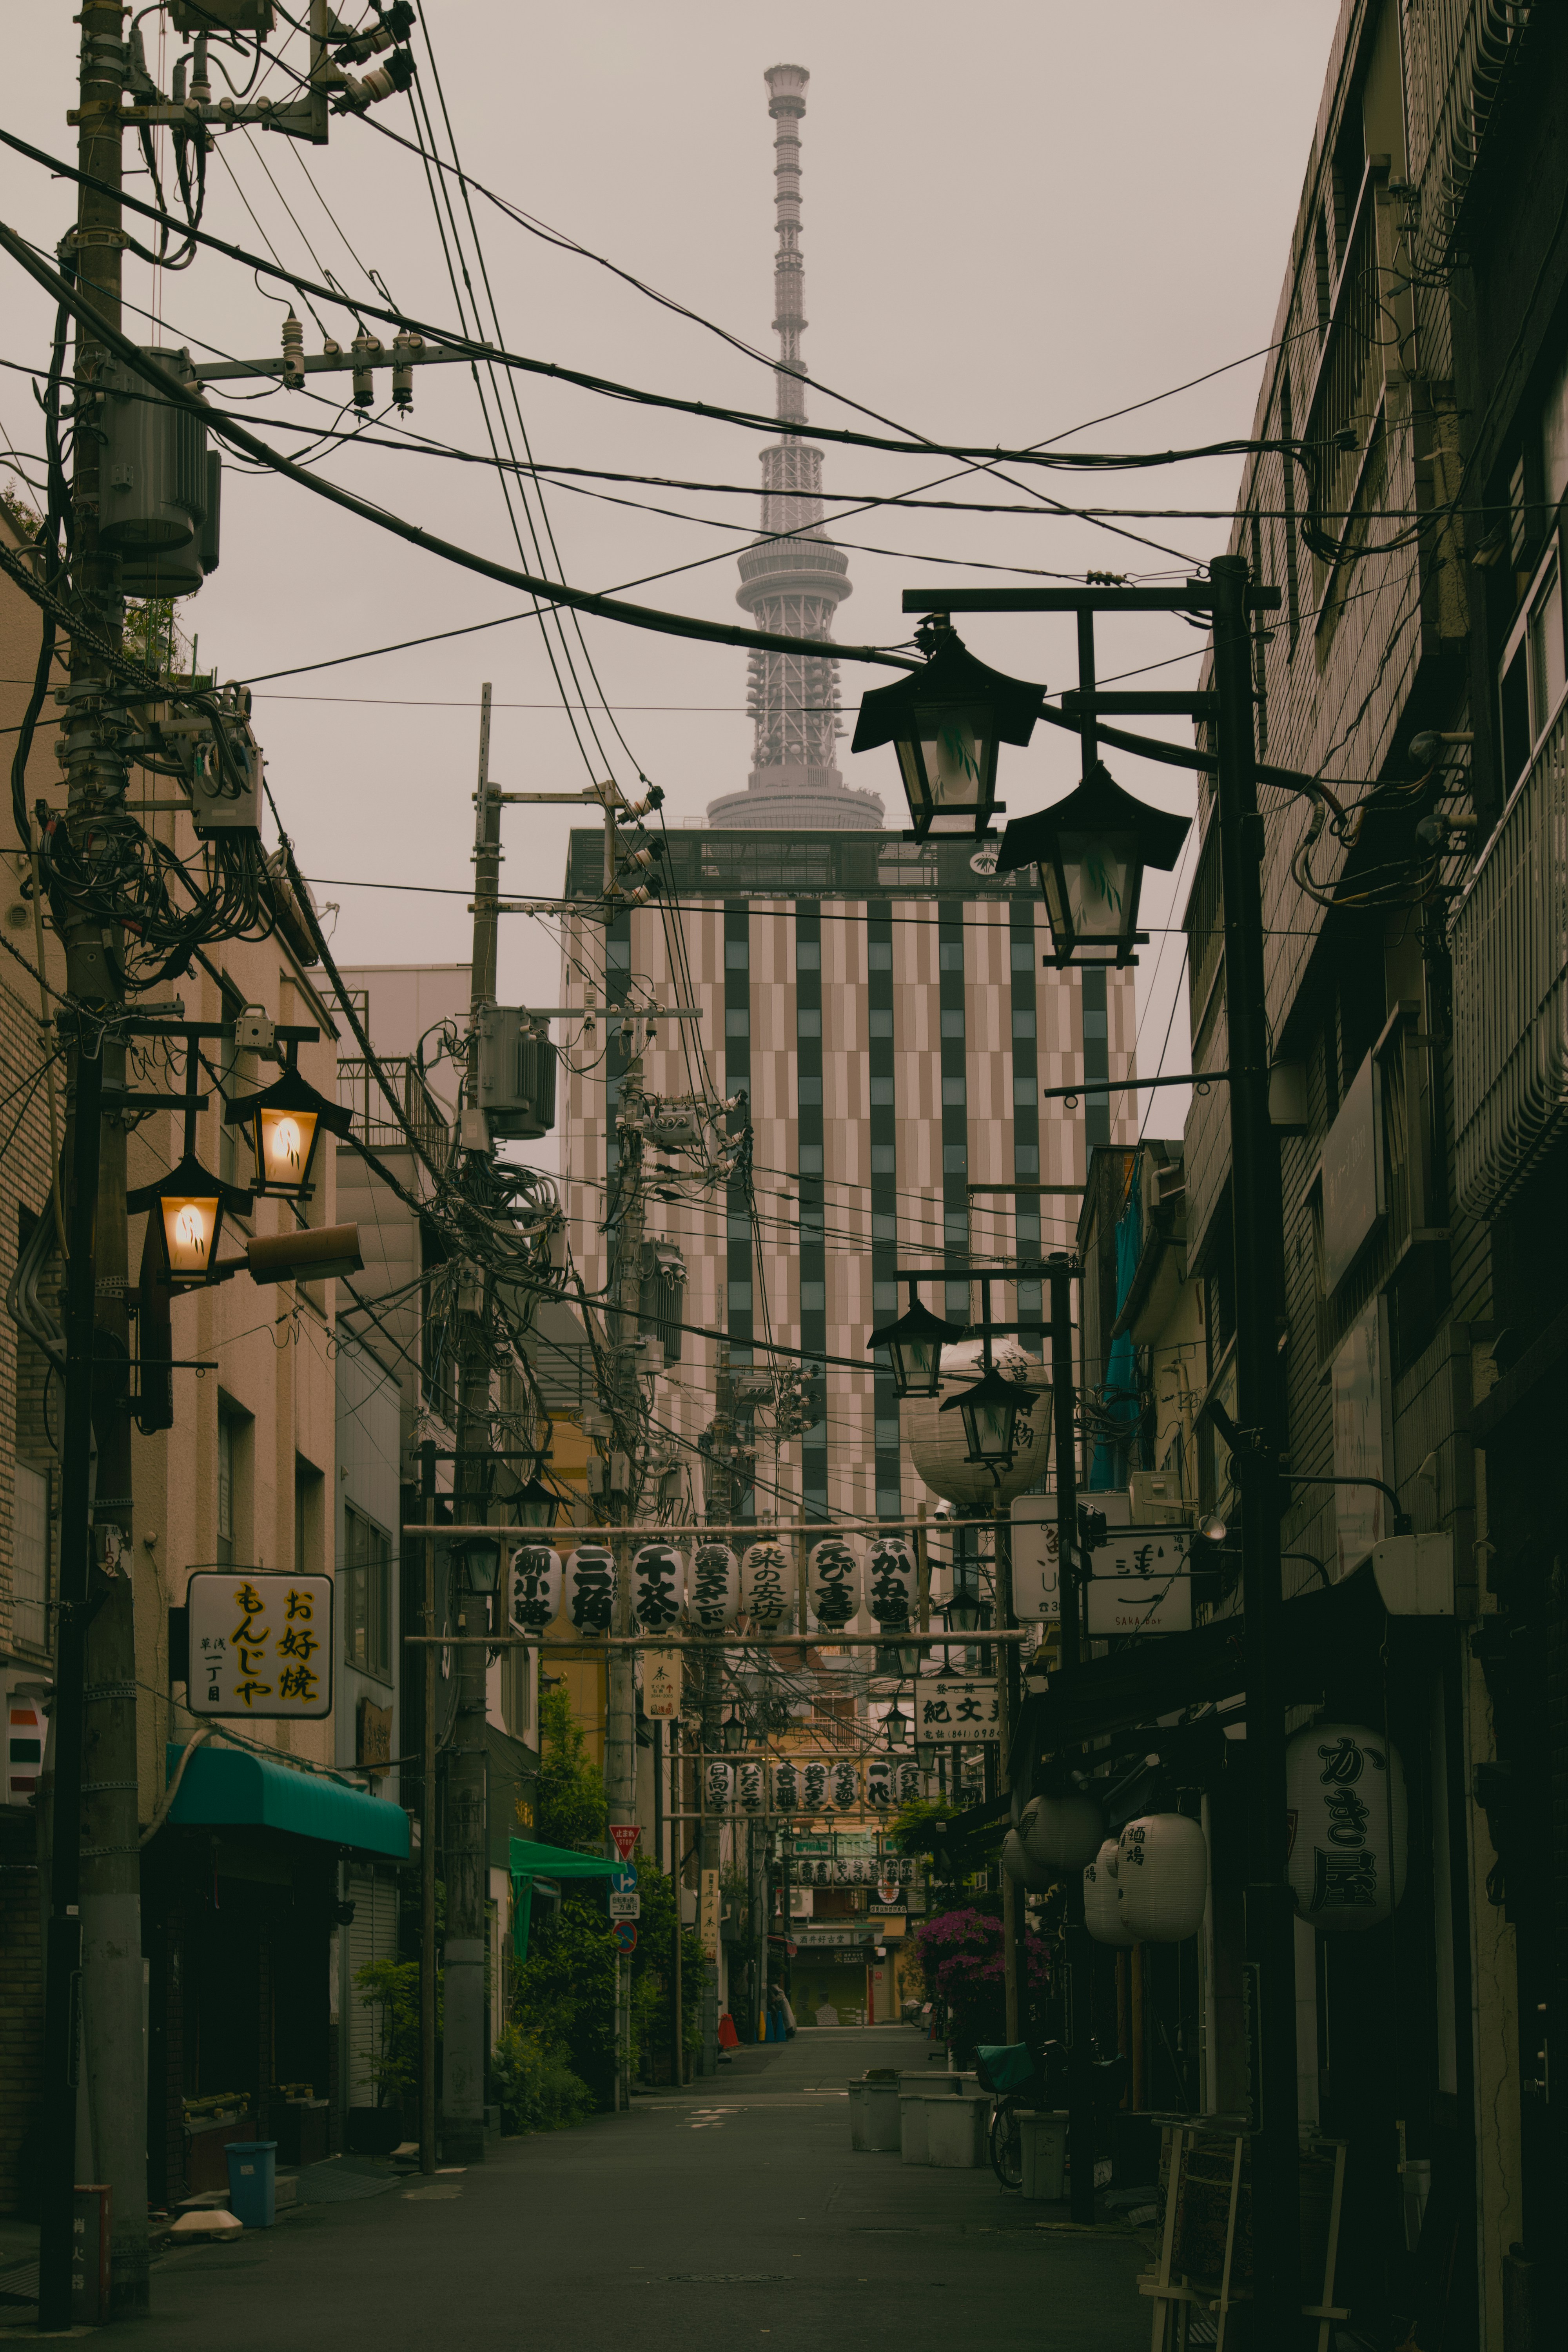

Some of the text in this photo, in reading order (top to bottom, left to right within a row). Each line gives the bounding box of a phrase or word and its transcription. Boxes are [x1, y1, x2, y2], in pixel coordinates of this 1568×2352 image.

[515, 1547, 552, 1626] 柳小路
[572, 1549, 613, 1630] 三角
[635, 1547, 679, 1625] 千茶
[748, 1548, 788, 1620] 染の安坊
[815, 1543, 856, 1621] えびす屋
[276, 1590, 319, 1702] お好焼
[709, 1764, 728, 1808] 日向亭
[869, 1764, 890, 1803] 一代
[1309, 1737, 1387, 1913] かき屋
[800, 1935, 844, 1944] 酒井好古堂
